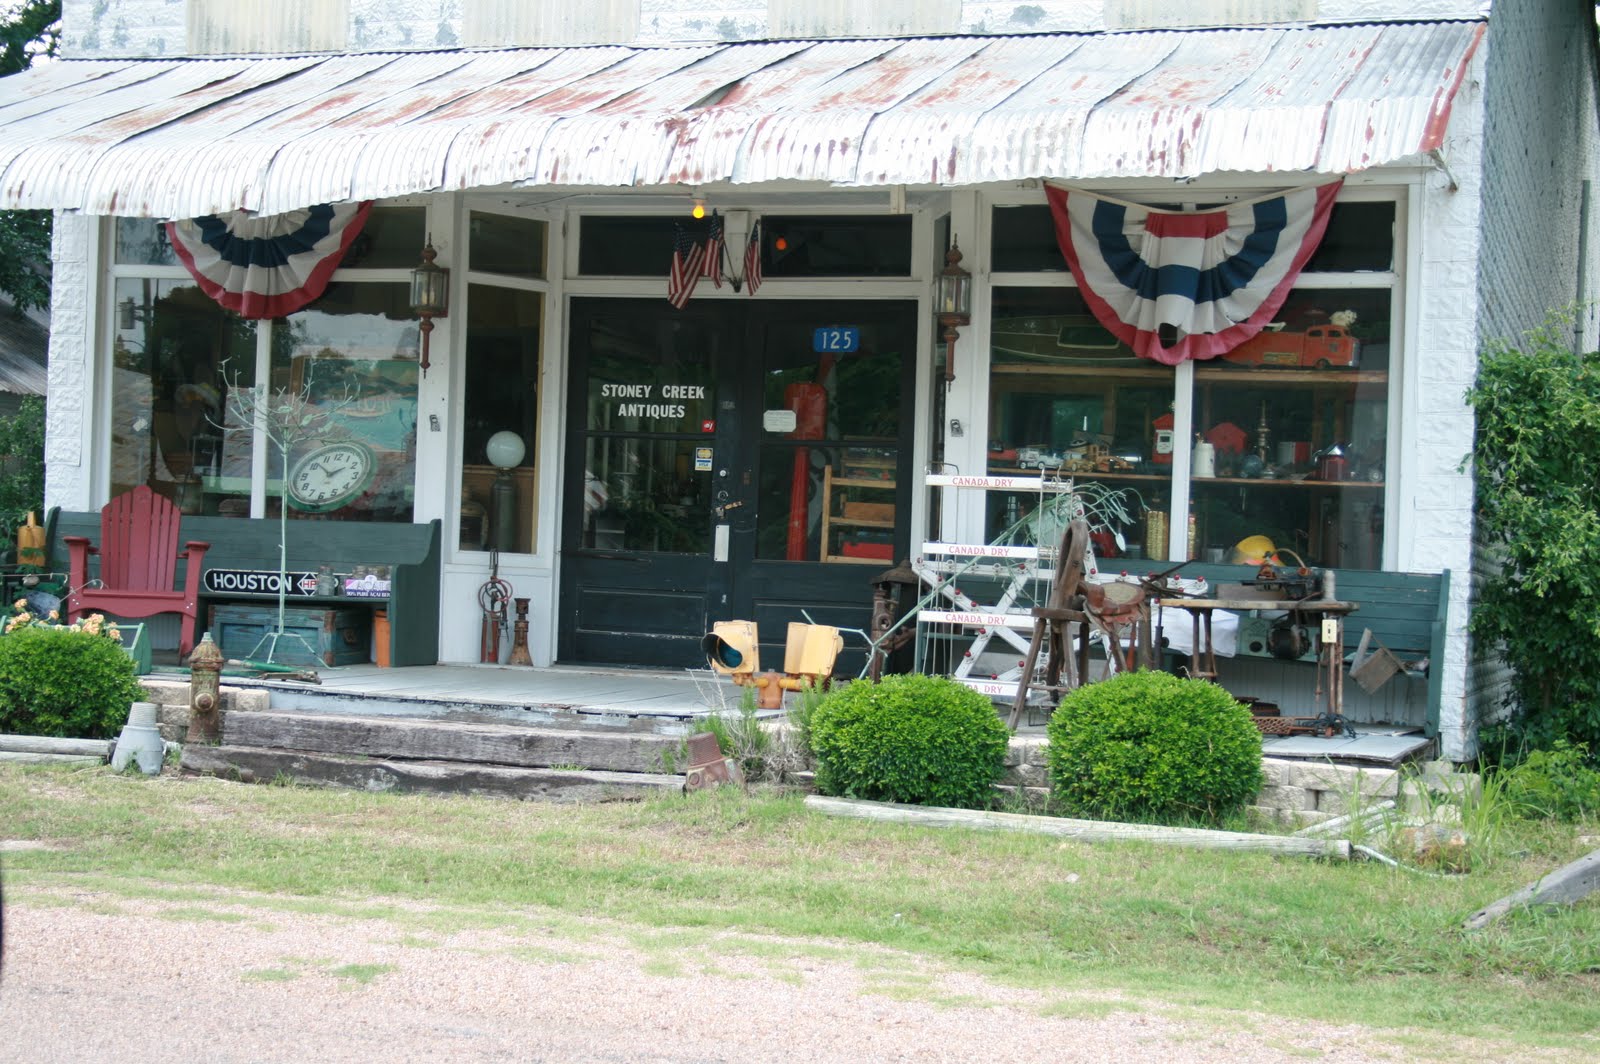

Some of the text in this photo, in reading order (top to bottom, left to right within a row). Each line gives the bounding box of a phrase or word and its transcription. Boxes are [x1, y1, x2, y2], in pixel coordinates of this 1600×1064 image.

[822, 331, 852, 349] 125
[601, 384, 705, 399] STONEY CREEK
[618, 403, 686, 419] ANTIQUES
[323, 455, 331, 463] 11
[334, 453, 344, 461] 12
[309, 462, 319, 471] 10
[350, 461, 358, 470] 2
[300, 472, 309, 481] 9
[351, 471, 359, 480] 3
[342, 482, 350, 490] 4
[952, 477, 1014, 487] CANADA DRY
[301, 483, 310, 491] 8
[308, 488, 316, 497] 7
[317, 491, 326, 500] 6
[330, 488, 339, 497] 5
[949, 546, 1010, 556] CANADA DRY
[213, 573, 292, 591] HOUSTON
[945, 613, 1006, 625] CANADA DRY
[984, 684, 1003, 694] DRY
